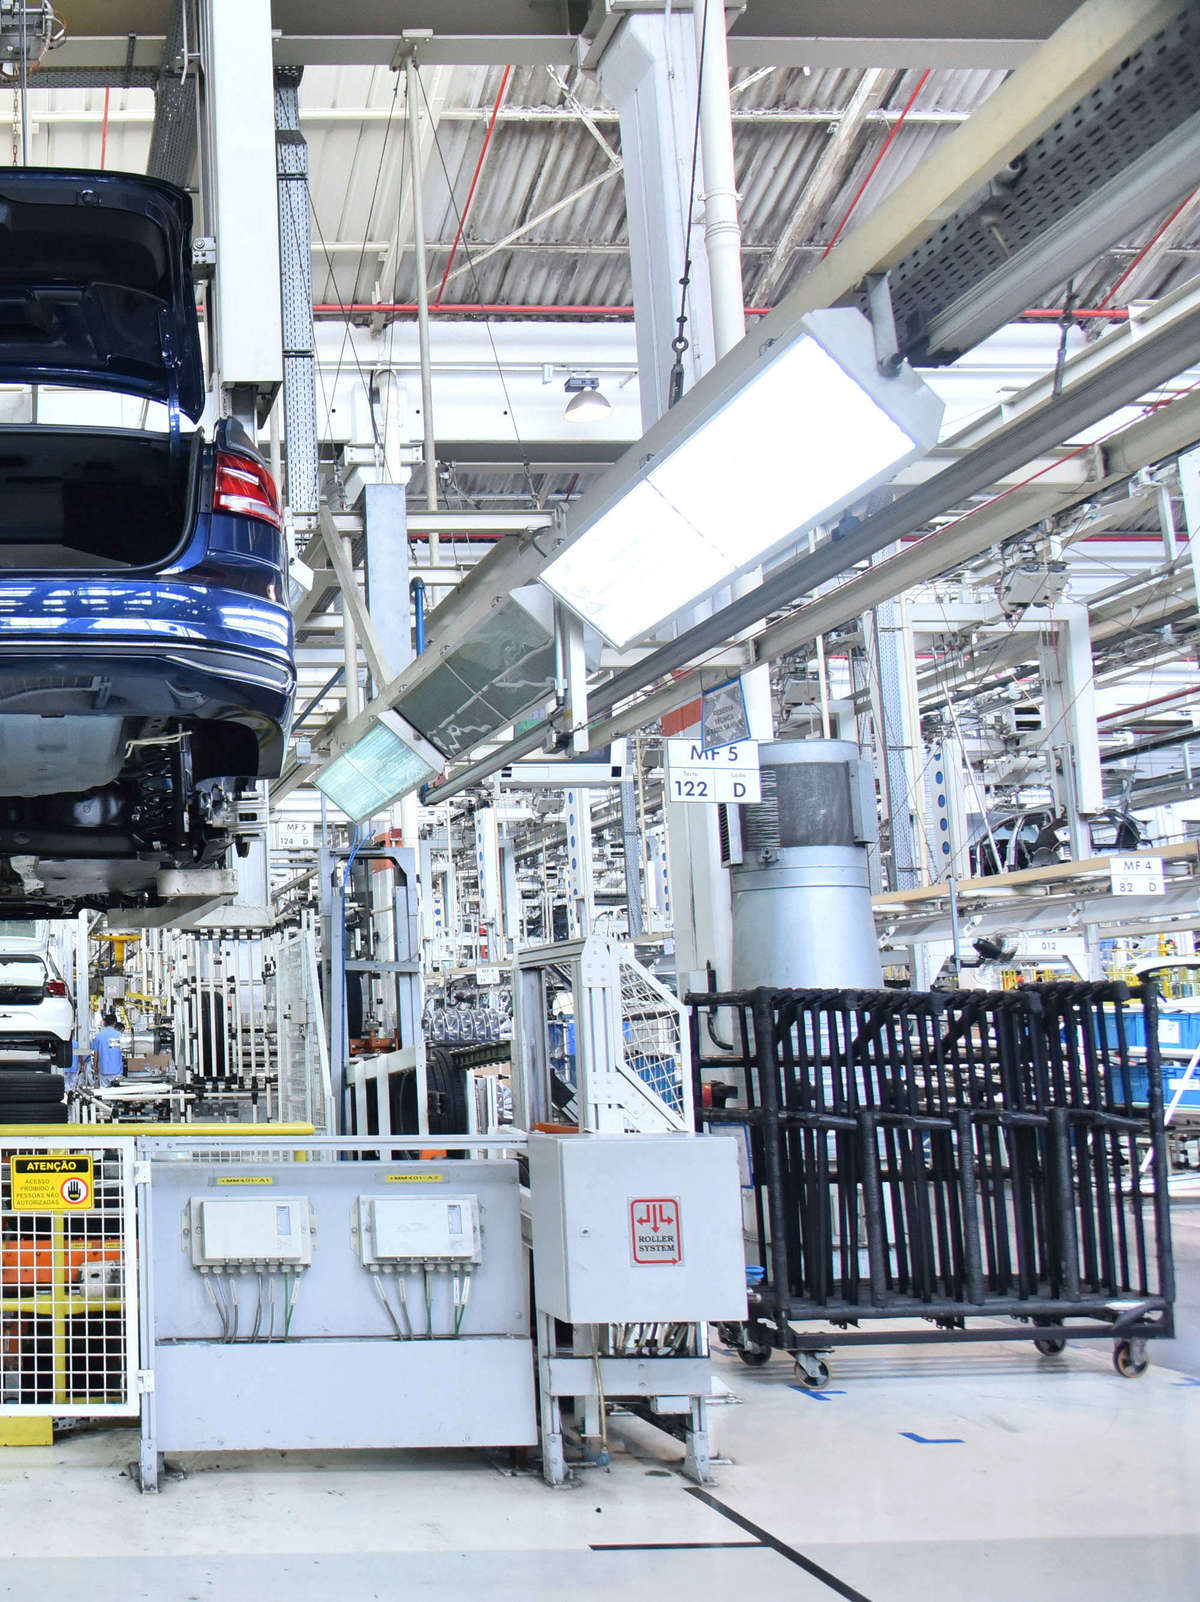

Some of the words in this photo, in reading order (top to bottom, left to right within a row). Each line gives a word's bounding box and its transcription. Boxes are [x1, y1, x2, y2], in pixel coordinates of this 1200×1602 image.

[728, 746, 738, 762] 5
[675, 780, 708, 796] 122
[733, 783, 746, 797] D
[287, 823, 299, 831] MF
[1123, 861, 1141, 871] MF
[1145, 861, 1152, 870] 4
[1149, 882, 1157, 892] D
[1041, 942, 1057, 951] 012
[26, 1160, 77, 1172] ATENÇÃO
[639, 1235, 674, 1243] ROLLER
[639, 1244, 675, 1252] SYSTEM
